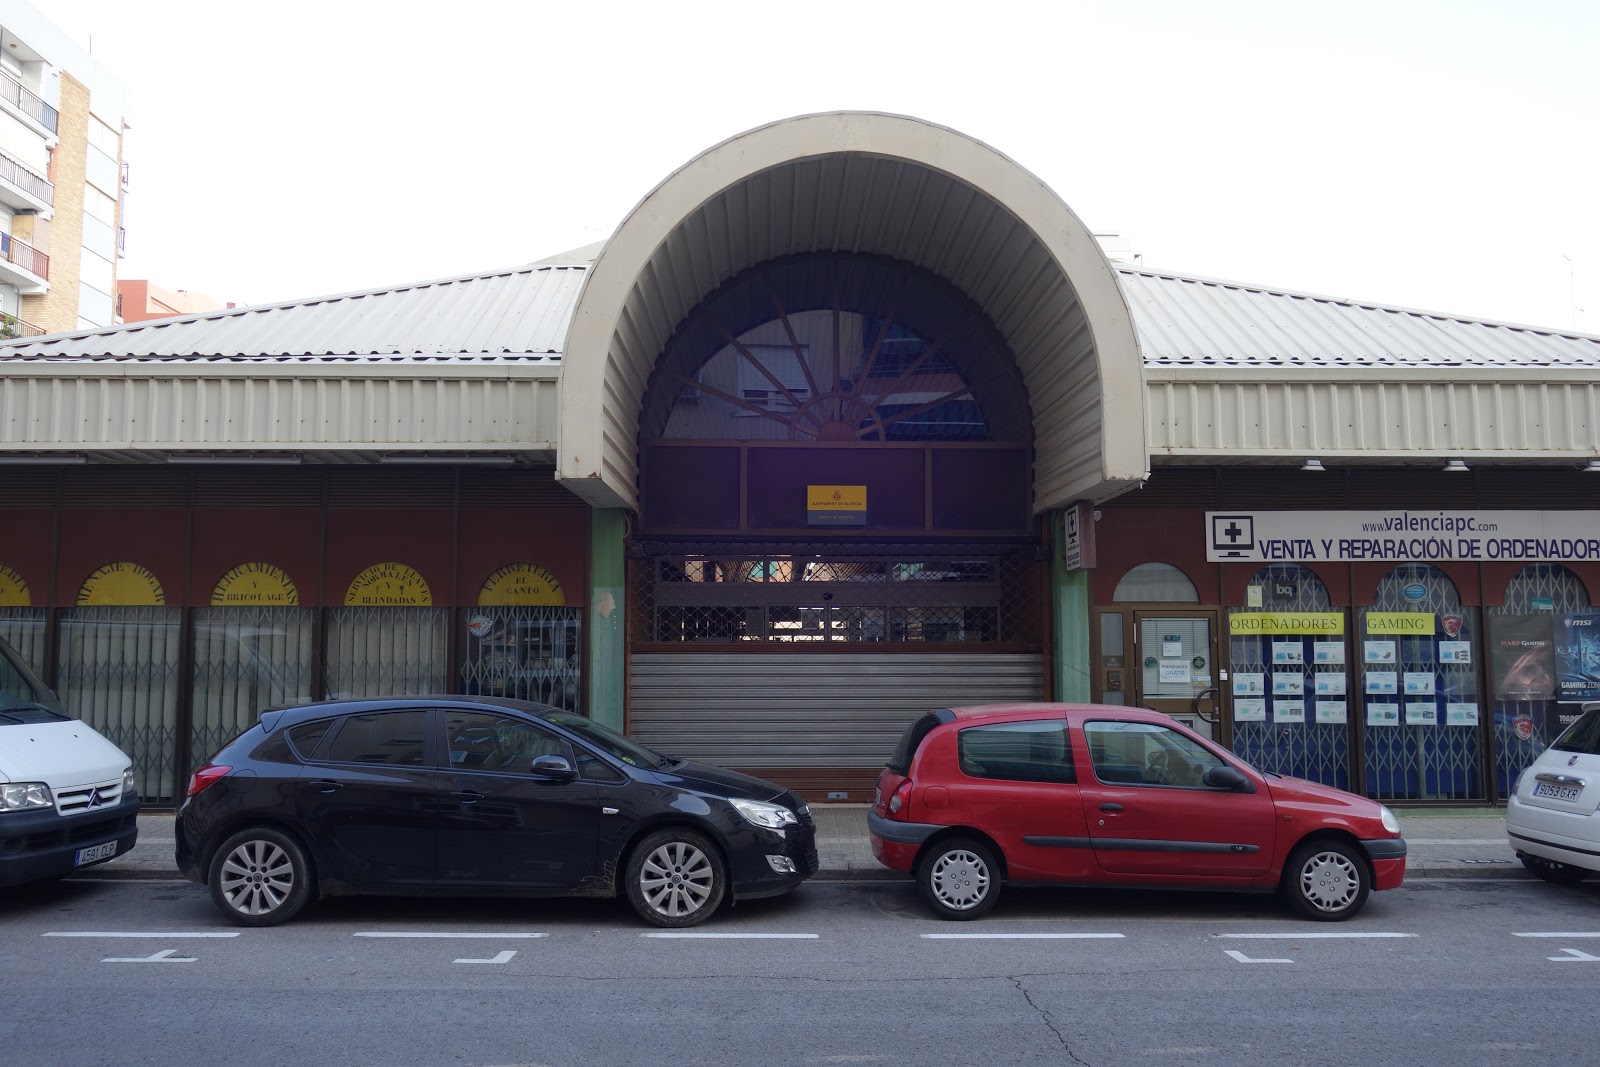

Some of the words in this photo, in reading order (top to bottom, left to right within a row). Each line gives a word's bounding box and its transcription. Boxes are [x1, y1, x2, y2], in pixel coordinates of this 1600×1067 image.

[1362, 512, 1498, 537] www.valenciapc.com
[1258, 539, 1316, 559] VENTA
[1321, 539, 1334, 559] Y
[1339, 536, 1453, 559] REPARACIÓN
[1458, 538, 1482, 559] DE
[76, 561, 125, 604] MENAJE
[132, 564, 166, 603] HOGAR
[211, 562, 299, 605] HERRAMIENTAS
[348, 565, 381, 603] SERVICIO
[384, 563, 398, 572] DE
[404, 567, 429, 603] LLAVES
[362, 570, 414, 590] NORMALES
[385, 582, 392, 590] Y
[484, 562, 560, 593] FERRETERIA
[506, 587, 540, 595] CANTO
[1276, 584, 1293, 597] bq
[362, 596, 416, 604] BLINDADAS
[1230, 618, 1337, 630] ORDENADORES
[1367, 618, 1424, 630] GAMING
[1561, 681, 1586, 689] GAMING
[1539, 785, 1560, 797] 9053
[1560, 788, 1578, 800] GXR
[81, 847, 98, 862] 4591
[101, 843, 114, 857] CLP
